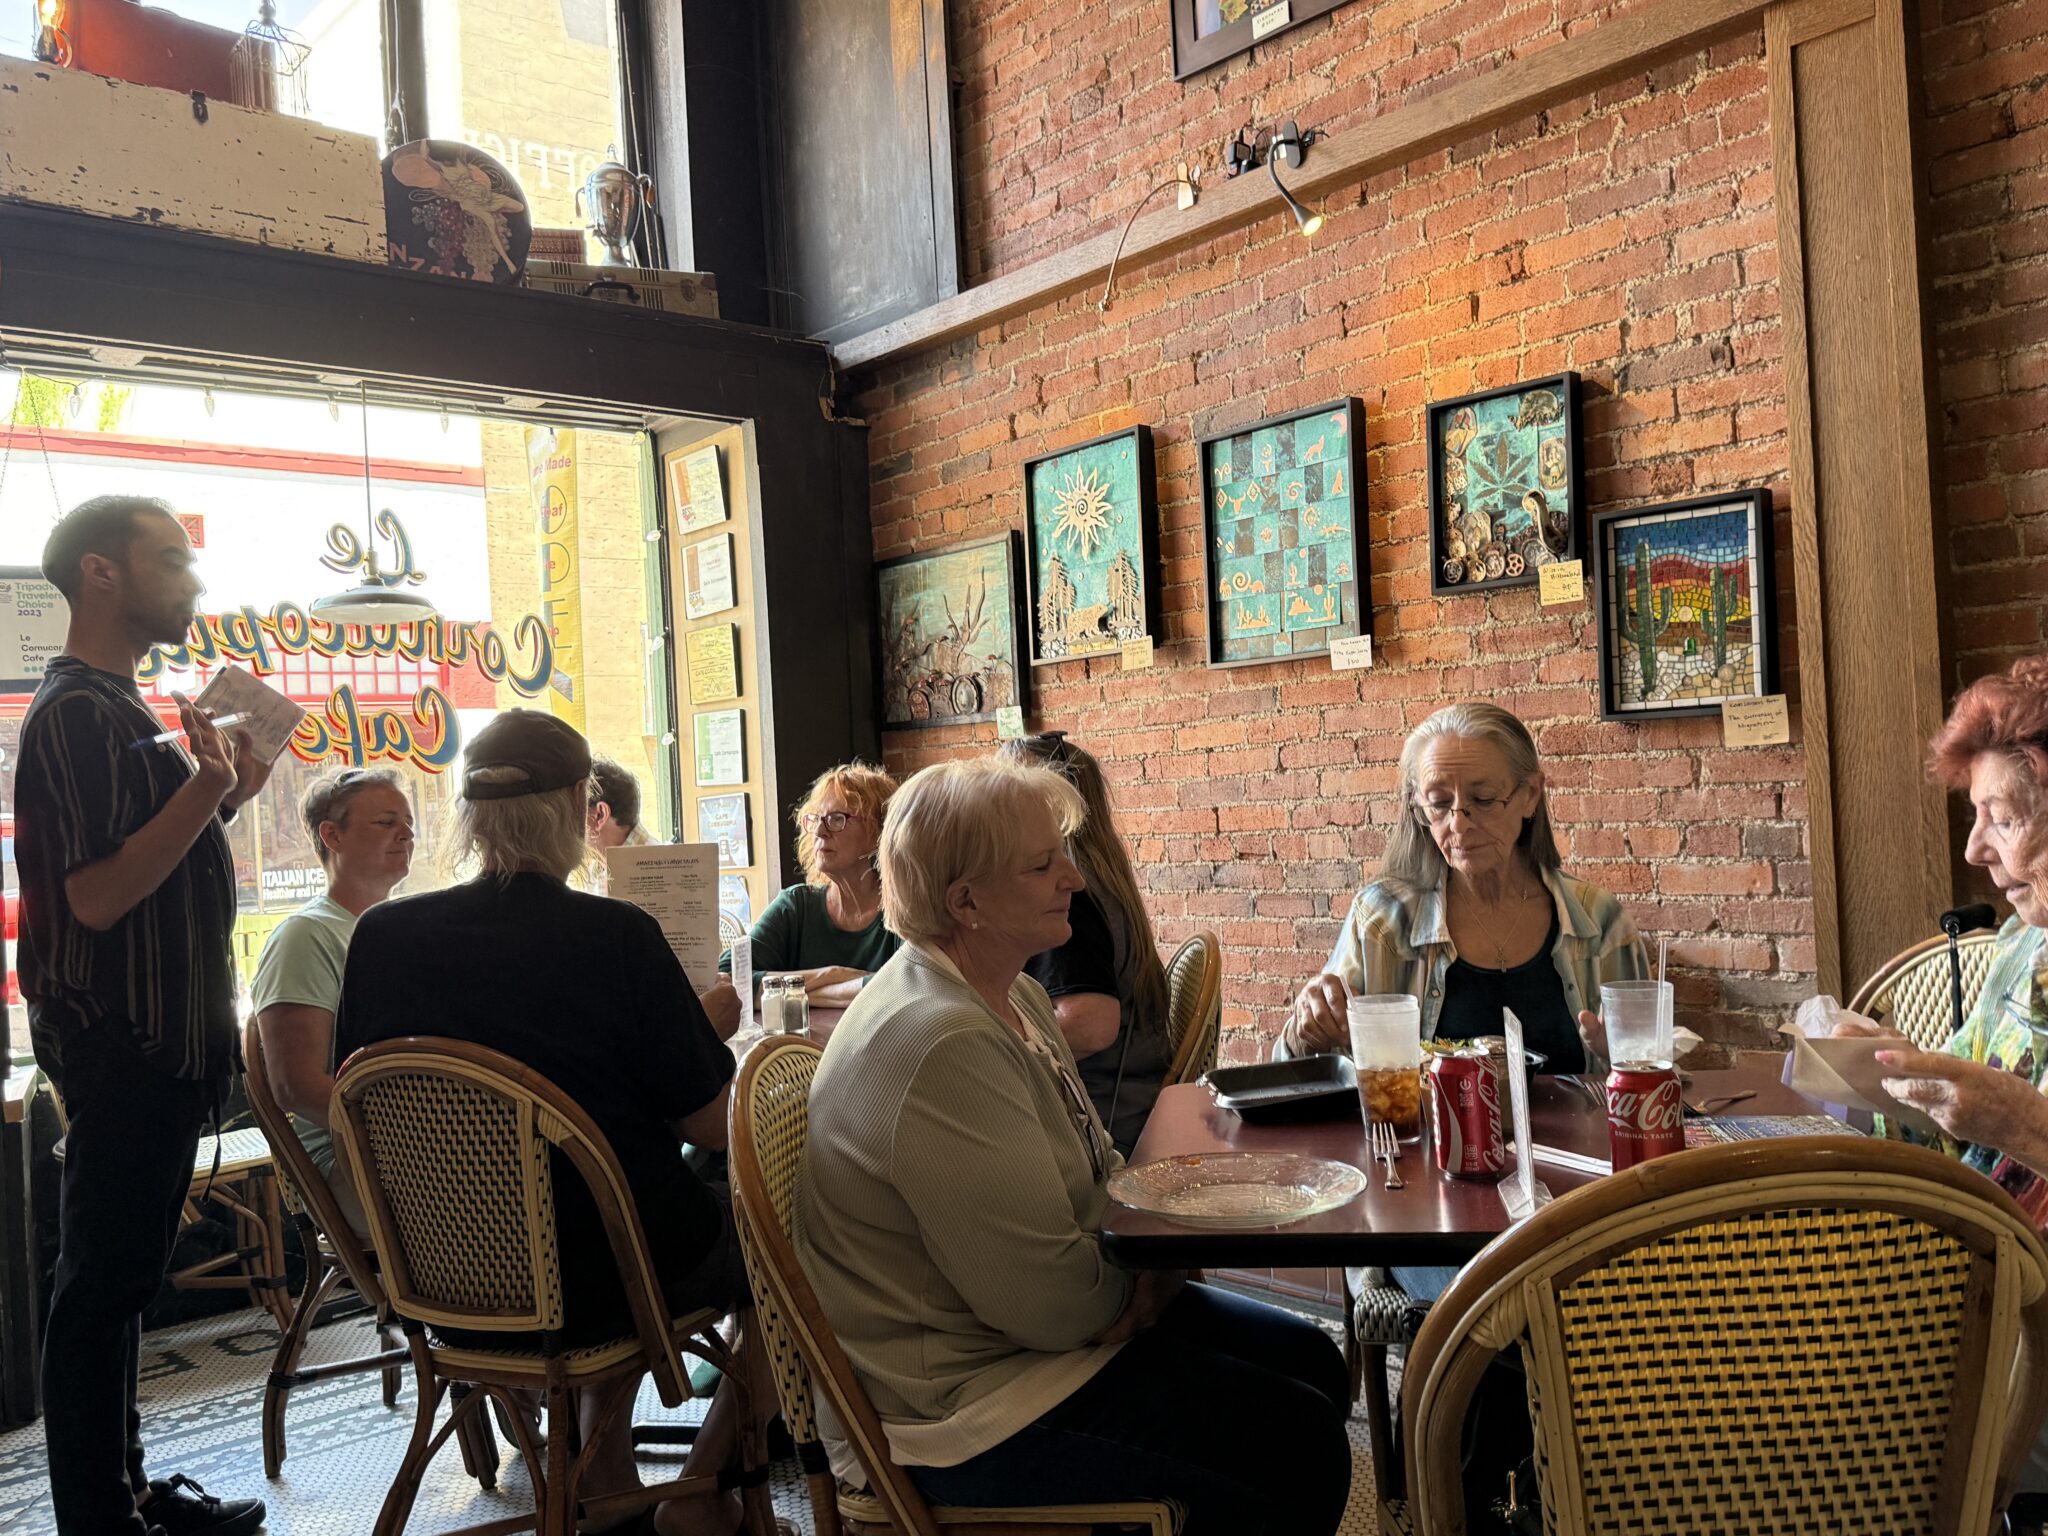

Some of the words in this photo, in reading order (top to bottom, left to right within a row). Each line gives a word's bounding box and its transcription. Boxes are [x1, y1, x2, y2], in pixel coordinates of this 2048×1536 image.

[15, 582, 55, 593] Tripadv
[17, 600, 54, 609] Choice
[17, 609, 42, 617] 2023
[20, 634, 31, 642] Le
[22, 654, 45, 662] Cafe
[262, 869, 305, 887] ITALIAN
[305, 868, 325, 885] ICE
[296, 885, 311, 898] and
[1615, 1131, 1648, 1140] ORIGINAL
[1650, 1132, 1674, 1140] TASTE
